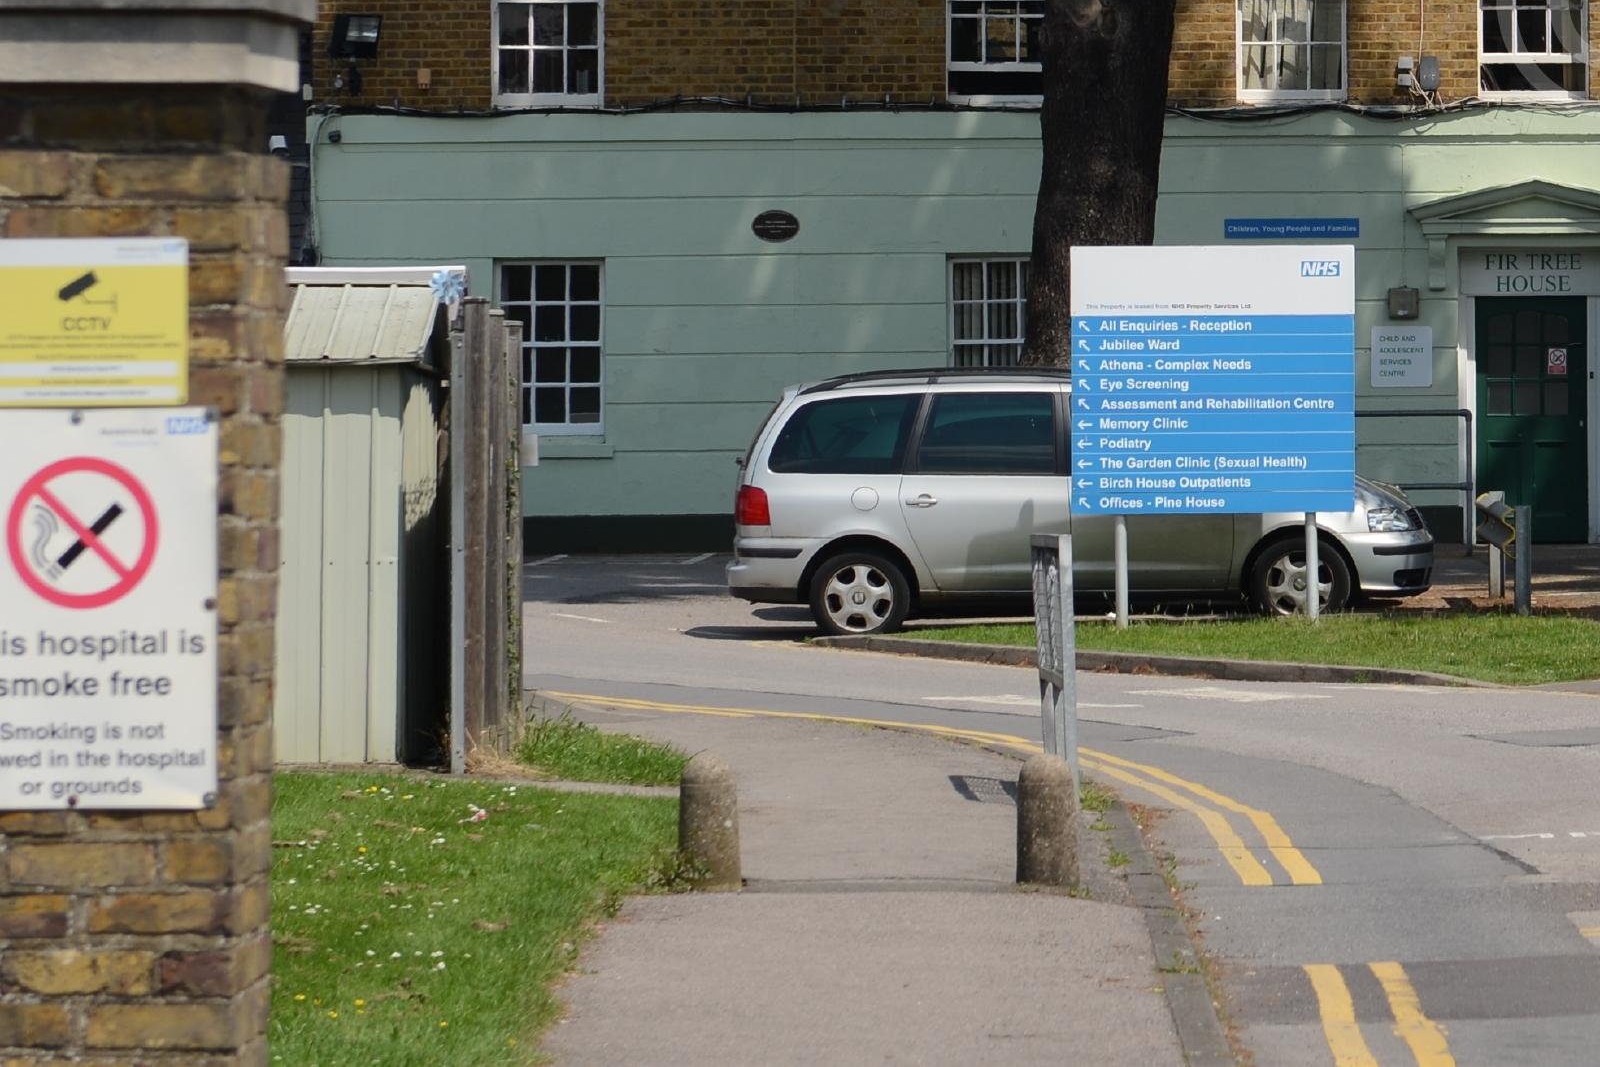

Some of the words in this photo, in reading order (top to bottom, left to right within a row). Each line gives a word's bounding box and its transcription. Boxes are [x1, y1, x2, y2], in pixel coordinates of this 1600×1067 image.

[1302, 261, 1339, 276] NHS
[1485, 253, 1518, 270] FIR
[1526, 253, 1582, 270] TREE
[1497, 275, 1571, 292] HOUSE
[63, 317, 111, 331] CCTV
[1100, 320, 1116, 331] All
[1119, 320, 1178, 333] Enquiries
[1190, 320, 1252, 333] Reception
[1099, 339, 1144, 350] Jubilee
[1148, 339, 1180, 350] Ward
[1099, 359, 1144, 370] Athena
[1155, 359, 1209, 372] Complex
[1213, 359, 1251, 370] Needs
[1100, 379, 1123, 392] Eye
[1126, 379, 1189, 392] Screening
[1101, 399, 1177, 410] Assessment
[1180, 399, 1202, 409] and
[1206, 398, 1290, 409] Rehabilitation
[1294, 398, 1335, 409] Centre
[1100, 419, 1149, 431] Memory
[1153, 418, 1188, 429] Clinic
[1100, 438, 1151, 451] Podiatry
[1100, 458, 1122, 469] The
[1126, 457, 1171, 468] Garden
[1176, 457, 1210, 468] Clinic
[1214, 456, 1259, 470] (Sexual
[1263, 456, 1307, 470] Health)
[1100, 477, 1132, 488] Birch
[1136, 477, 1176, 488] House
[1180, 477, 1251, 490] Outpatients
[1100, 497, 1143, 508] Offices
[1155, 497, 1182, 508] Pine
[1186, 497, 1225, 508] House
[38, 630, 167, 662] hospital
[179, 629, 205, 655] is
[110, 670, 171, 696] free
[0, 722, 97, 744] Smoking
[104, 722, 122, 740] is
[129, 722, 165, 739] not
[50, 750, 68, 767] in
[76, 750, 111, 767] the
[118, 749, 206, 770] hospital
[20, 781, 43, 795] or
[51, 778, 143, 799] grounds
